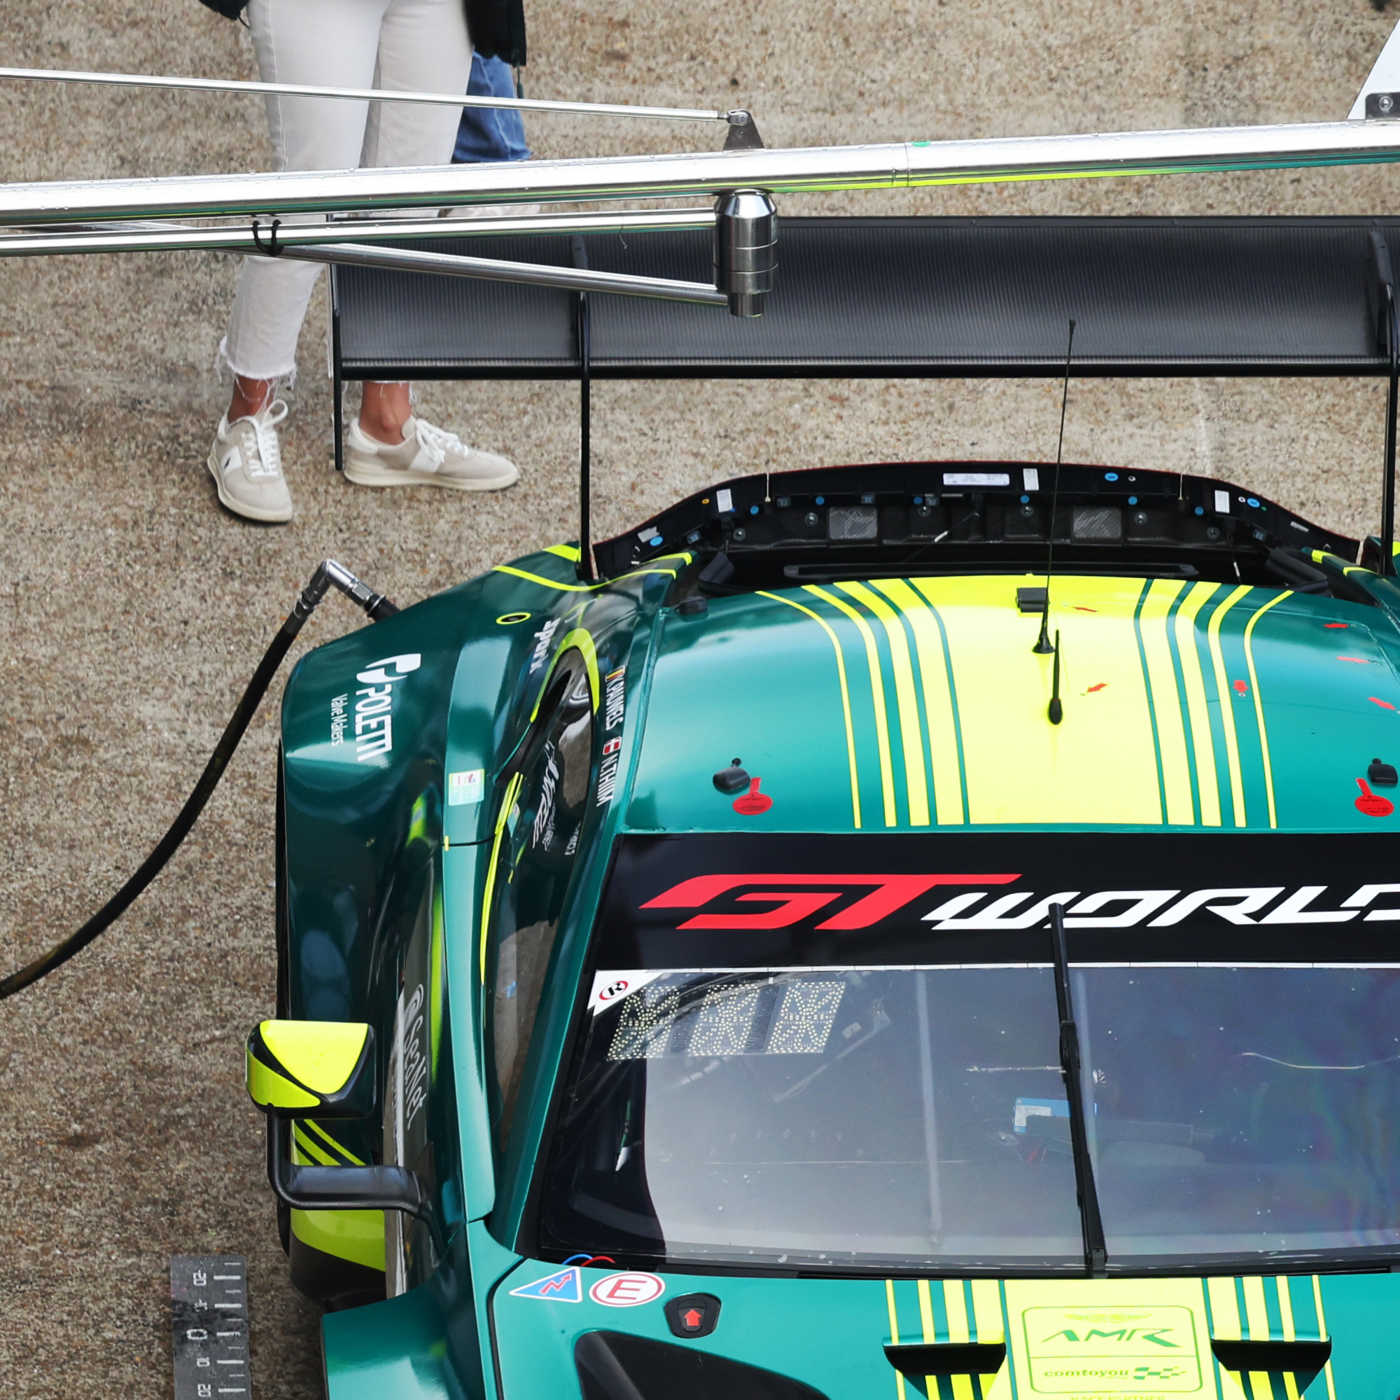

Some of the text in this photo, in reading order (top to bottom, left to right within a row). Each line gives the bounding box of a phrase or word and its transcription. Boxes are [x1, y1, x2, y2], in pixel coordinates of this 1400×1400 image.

[356, 683, 393, 762] POLETTI
[639, 873, 1022, 930] GT
[614, 1280, 647, 1300] E
[1041, 1328, 1182, 1348] AMR
[1043, 1369, 1129, 1380] comtoyou
